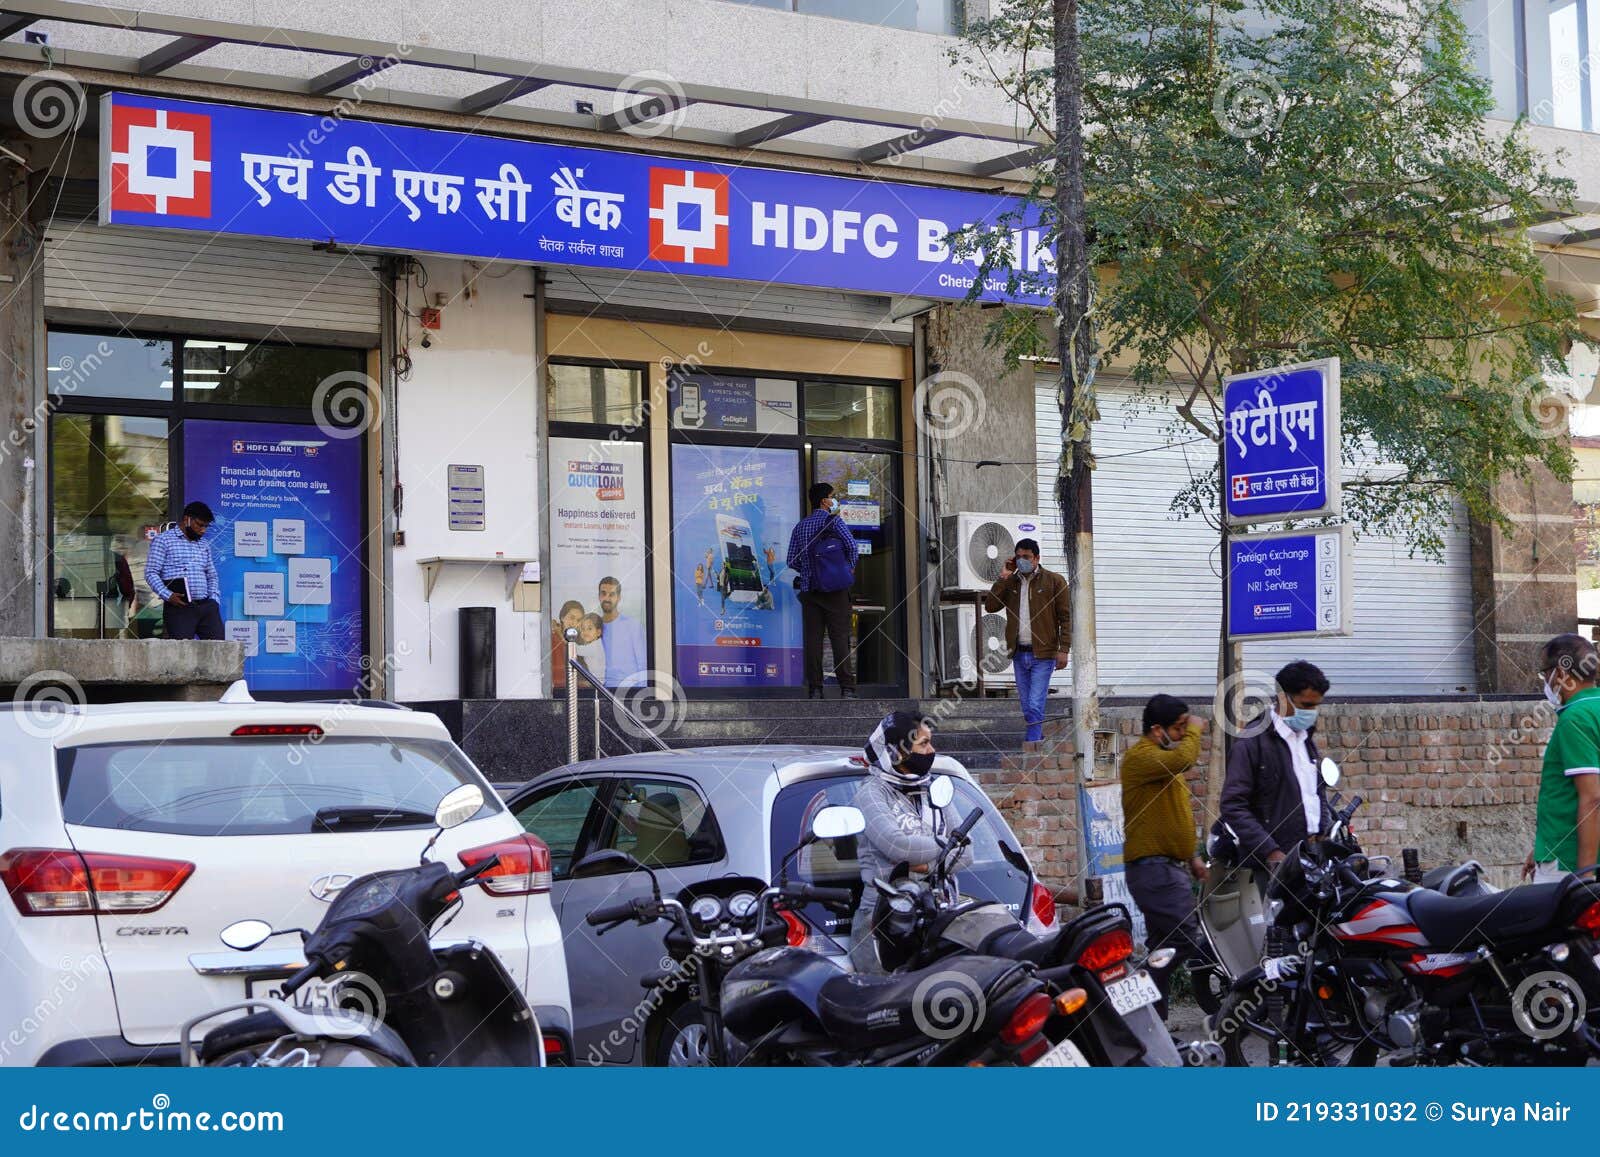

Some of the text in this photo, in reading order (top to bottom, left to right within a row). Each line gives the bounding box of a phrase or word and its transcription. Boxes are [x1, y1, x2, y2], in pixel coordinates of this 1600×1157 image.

[241, 146, 625, 231] एच डी एफ सी बैंक
[751, 201, 899, 260] HDFC
[539, 235, 625, 258] चेतक सर्कल शाखा
[939, 274, 978, 289] Cheta
[984, 279, 1017, 292] Circ
[721, 415, 748, 423] GoDigital
[1230, 389, 1318, 459] एटीएम
[246, 444, 292, 453] HDFC BANK
[221, 466, 301, 478] Financial solutions to
[221, 477, 328, 489] help your dreams come alive
[568, 473, 624, 488] QUICKLOAN
[1251, 473, 1314, 494] एच डी एफ सी बैंक
[260, 494, 282, 502] today's
[558, 508, 636, 520] Happiness delivered
[1237, 548, 1309, 563] Foreign Exchange
[1265, 564, 1281, 576] and
[1248, 580, 1298, 593] NRI Services
[116, 926, 189, 936] CRETA
